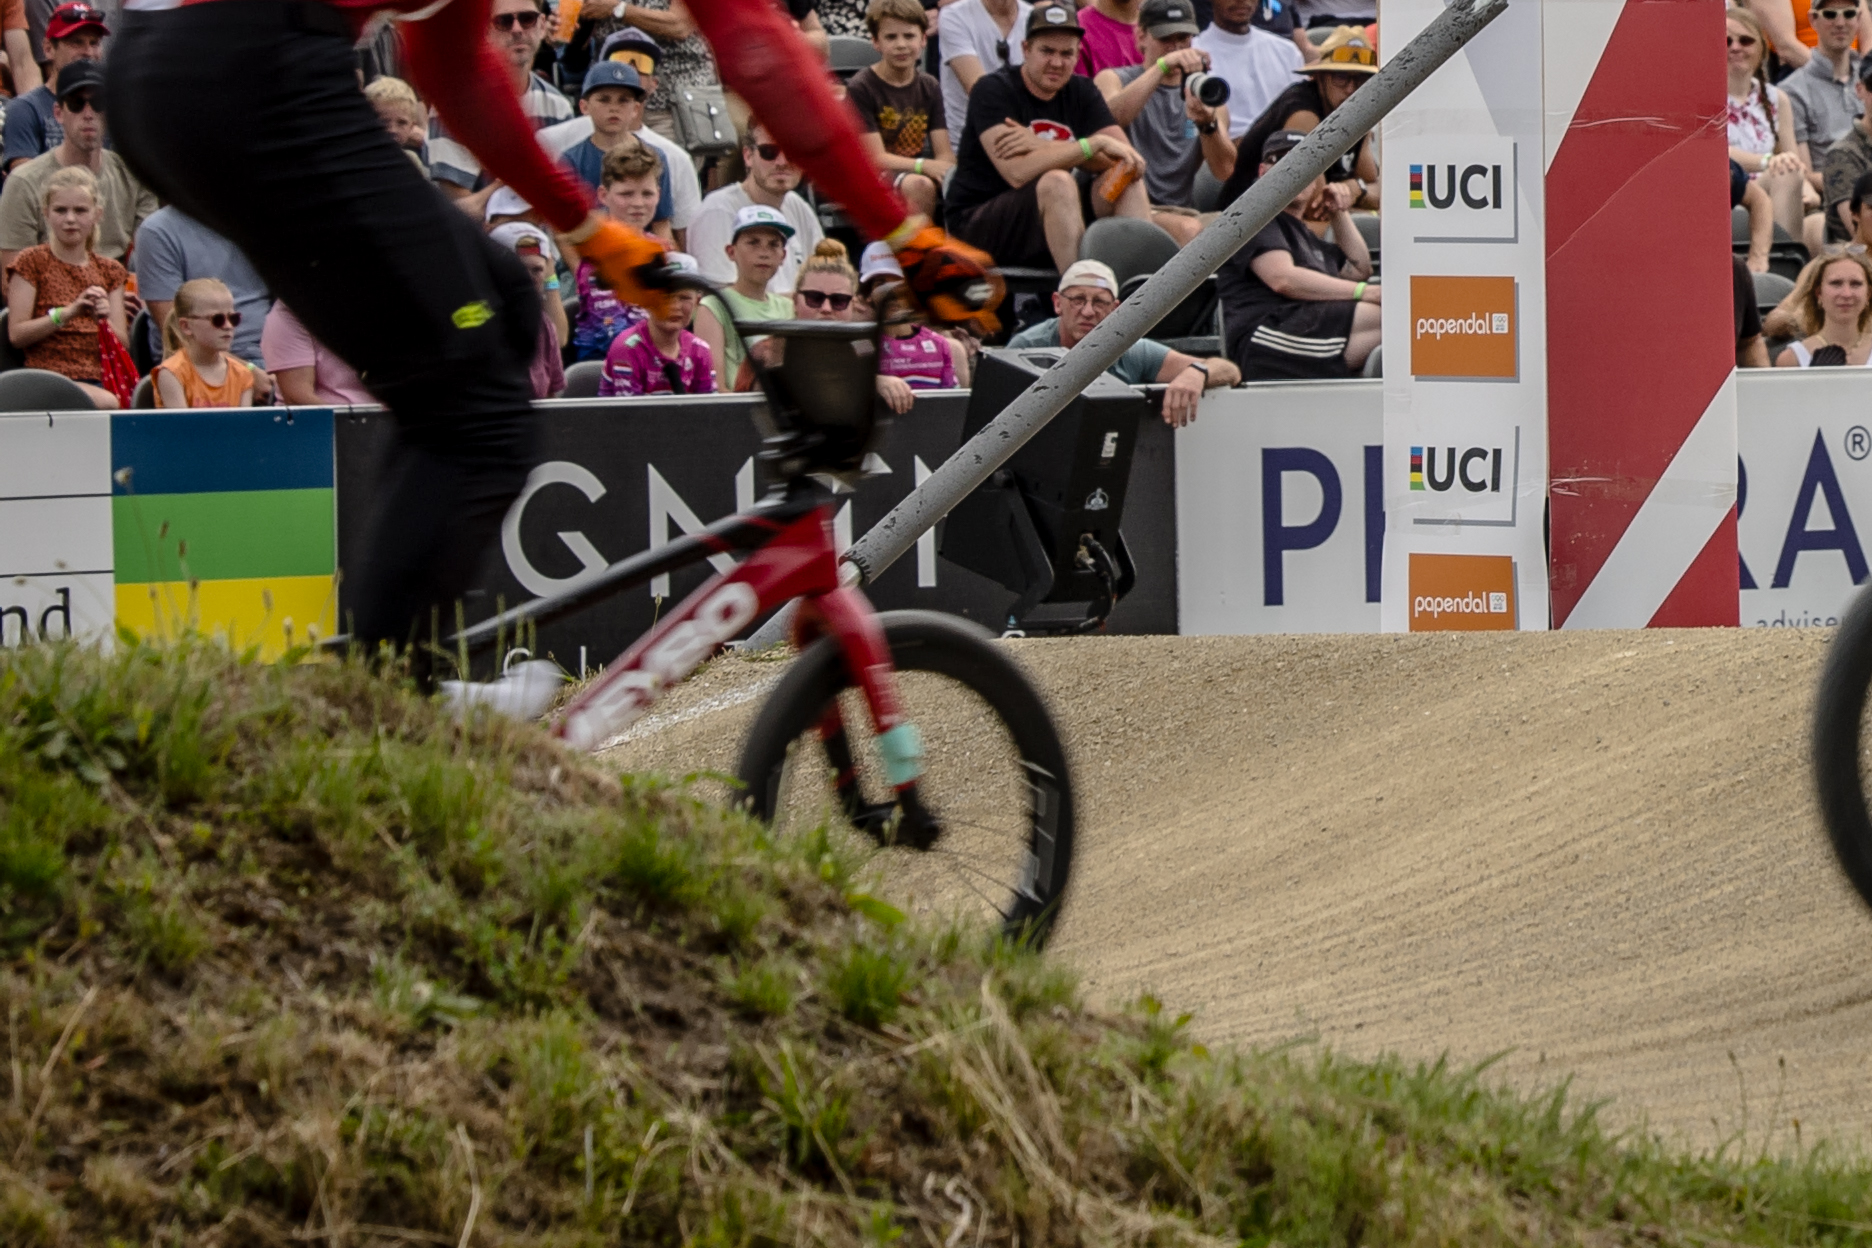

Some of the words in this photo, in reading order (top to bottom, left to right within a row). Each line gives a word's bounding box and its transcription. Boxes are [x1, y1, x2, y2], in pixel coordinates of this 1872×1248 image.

[1427, 164, 1502, 210] UCI
[1416, 312, 1491, 340] papendal
[1427, 446, 1502, 493] UCI
[1414, 591, 1488, 619] papendal
